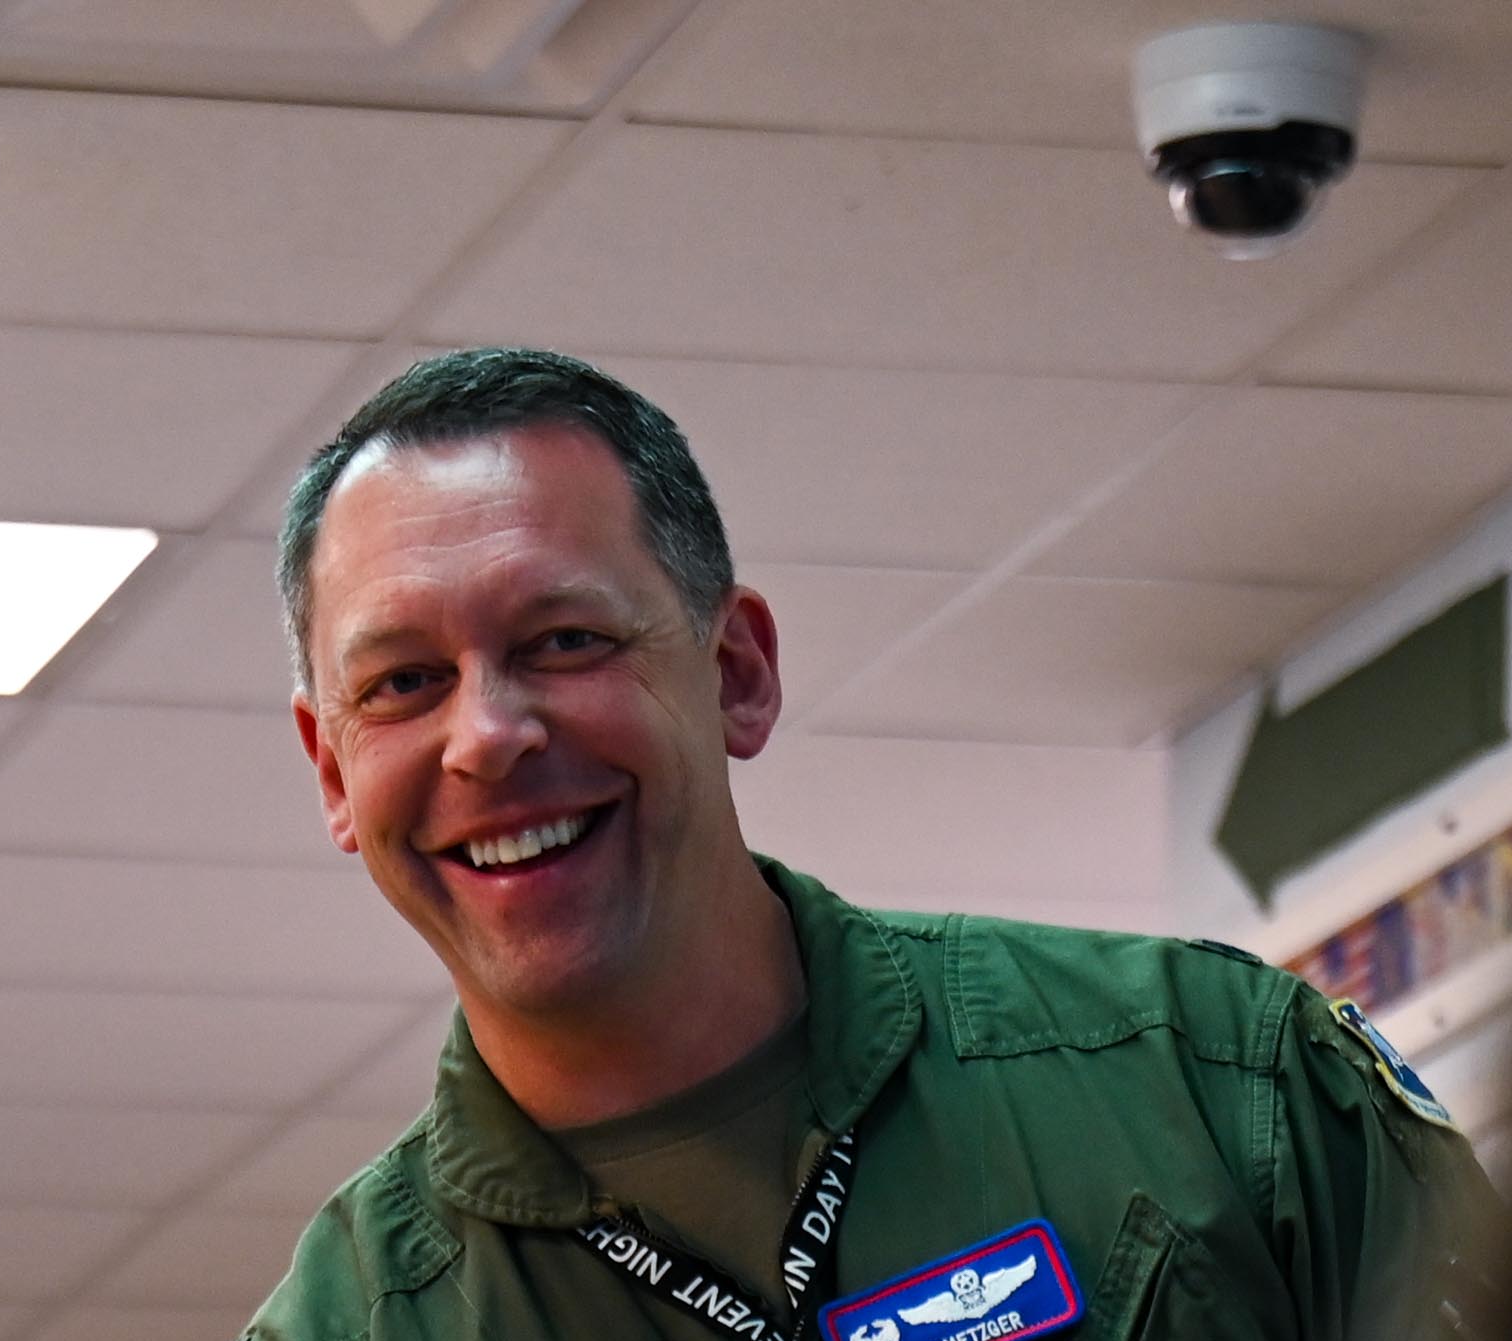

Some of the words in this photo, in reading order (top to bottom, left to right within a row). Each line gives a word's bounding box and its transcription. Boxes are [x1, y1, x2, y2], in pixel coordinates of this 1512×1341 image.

[578, 1224, 673, 1286] NIGH
[784, 1246, 817, 1310] IN
[802, 1169, 846, 1246] DAY
